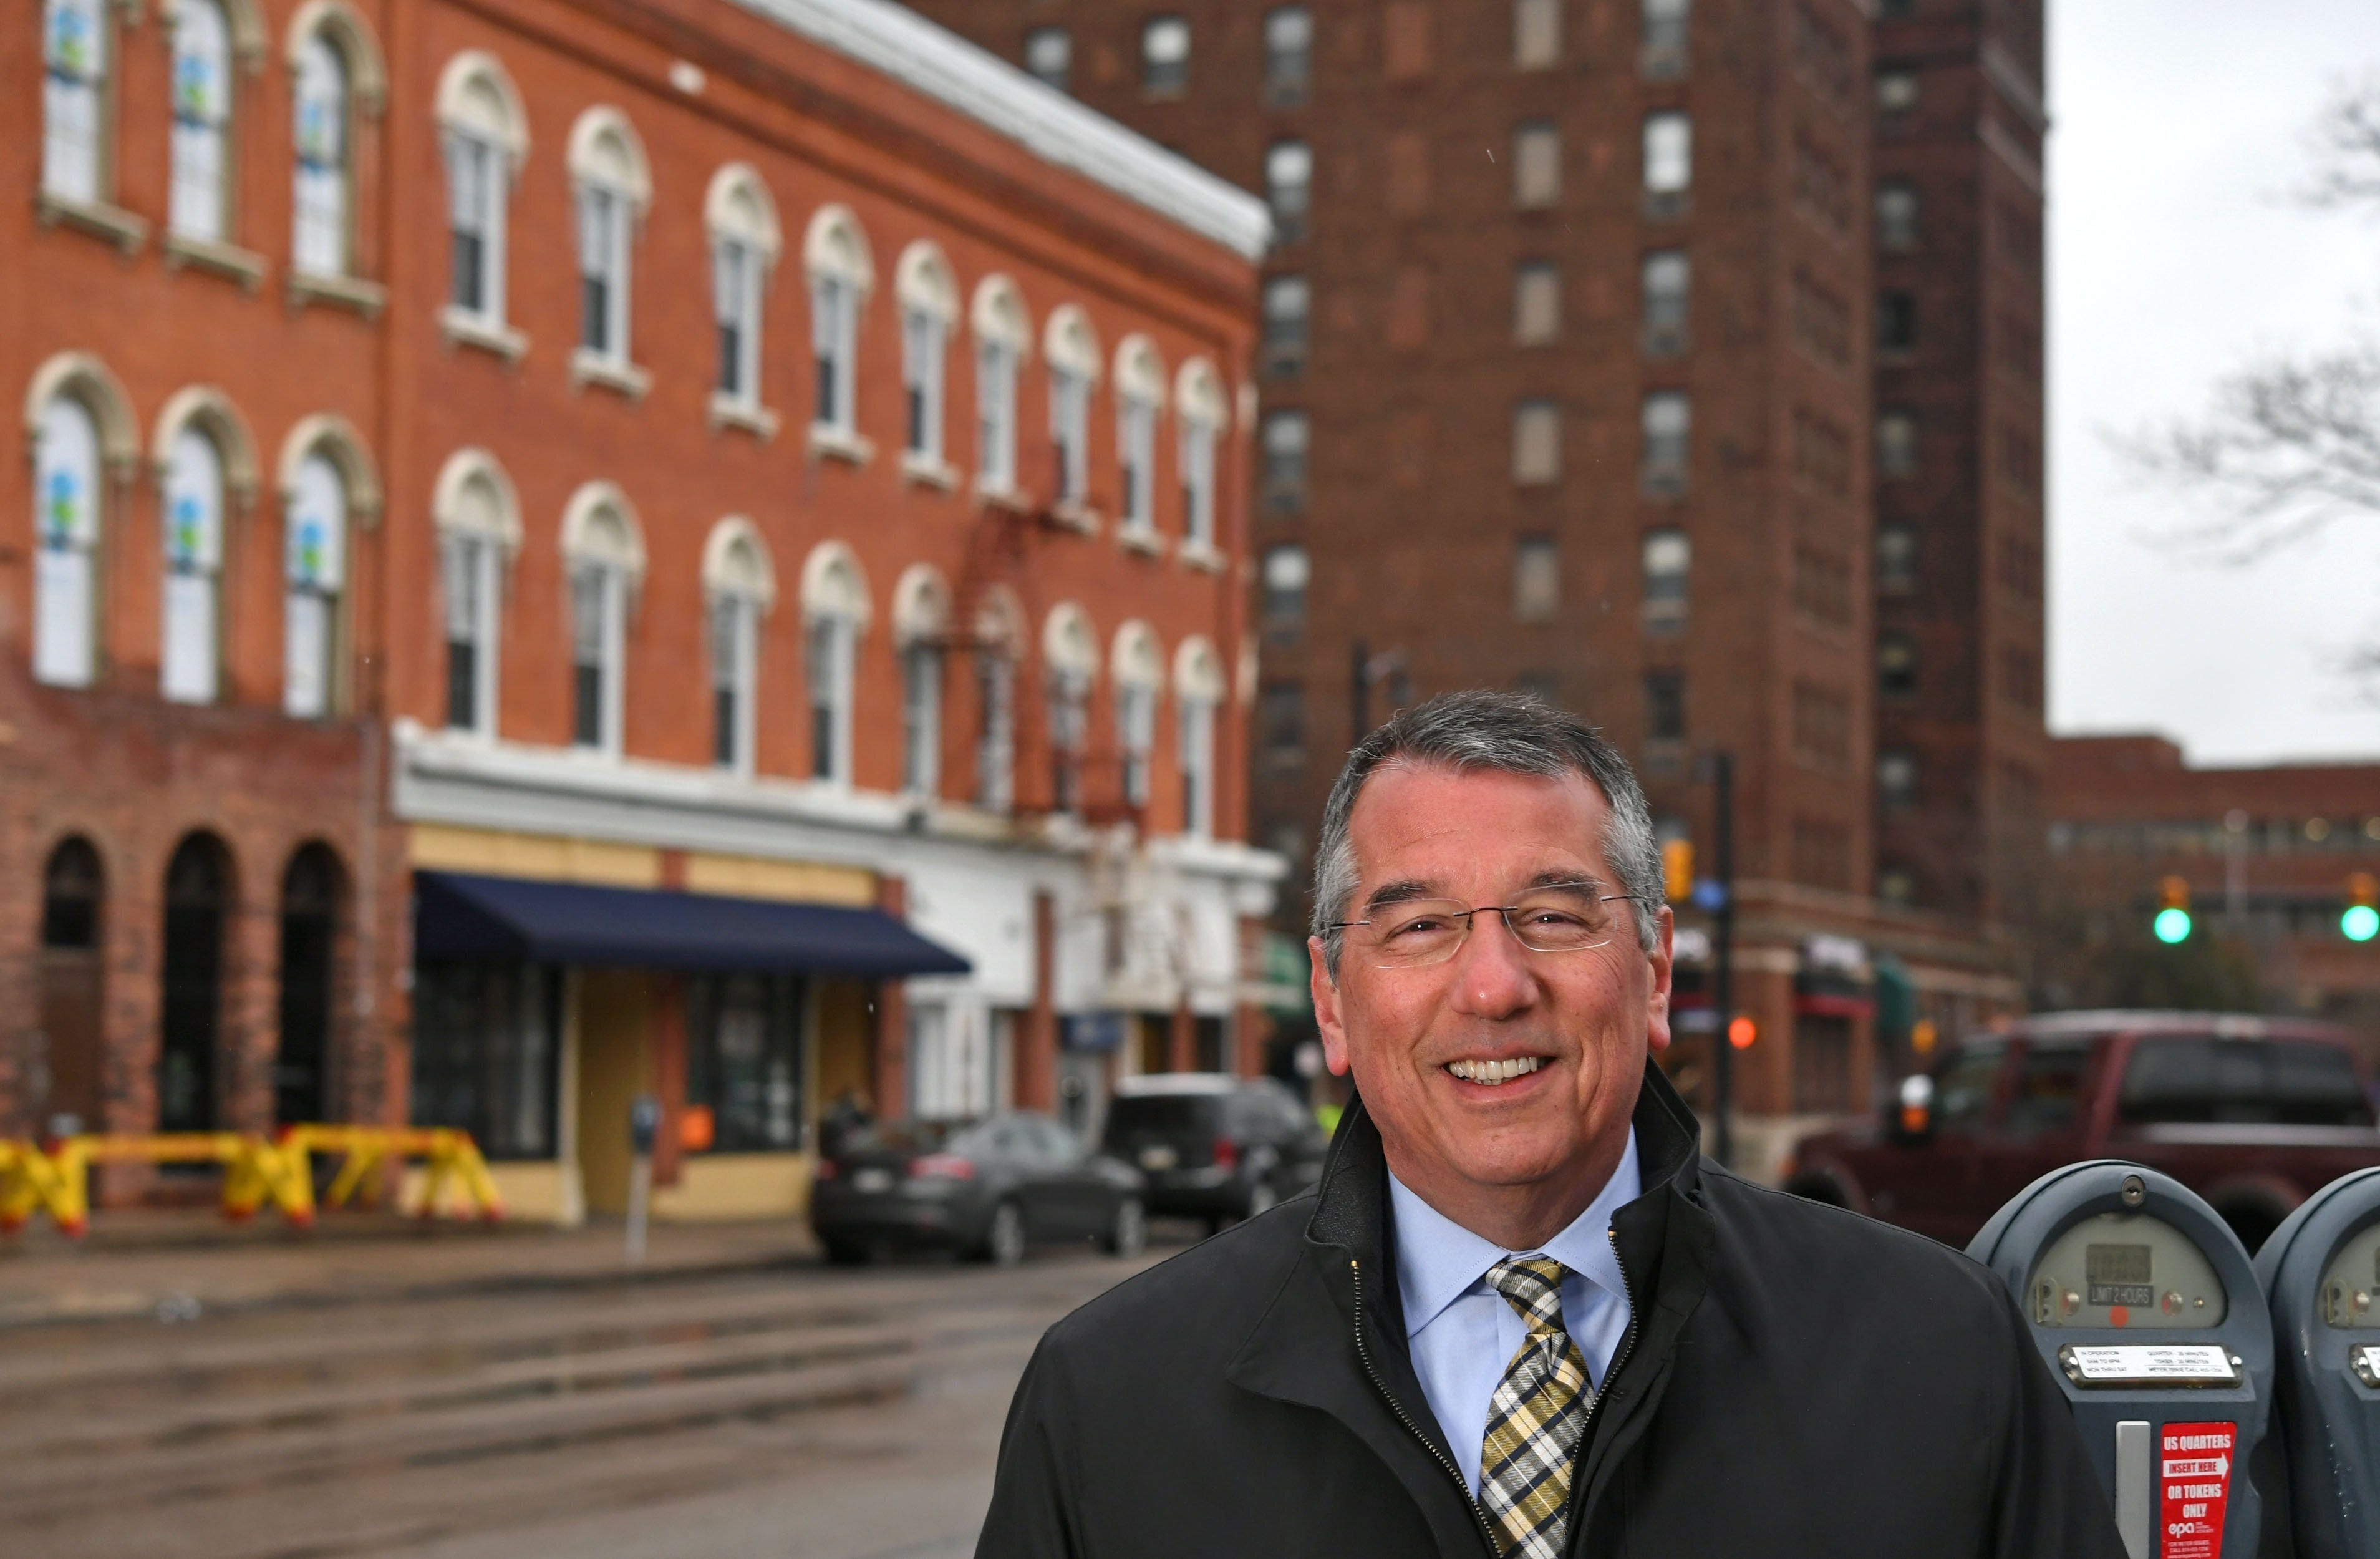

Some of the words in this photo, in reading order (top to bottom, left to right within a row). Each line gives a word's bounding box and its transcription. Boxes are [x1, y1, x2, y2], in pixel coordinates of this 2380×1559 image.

[2092, 1287, 2112, 1303] LIMIT
[2113, 1287, 2119, 1303] 2
[2121, 1287, 2149, 1304] HOURS
[2164, 1436, 2178, 1450] US
[2180, 1434, 2231, 1452] QUARTERS
[2169, 1462, 2195, 1474] INSERT
[2198, 1462, 2217, 1472] HERE
[2167, 1485, 2182, 1500] OR
[2184, 1484, 2222, 1498] TOKENS
[2183, 1503, 2207, 1518] ONLY
[2168, 1522, 2194, 1538] epa
